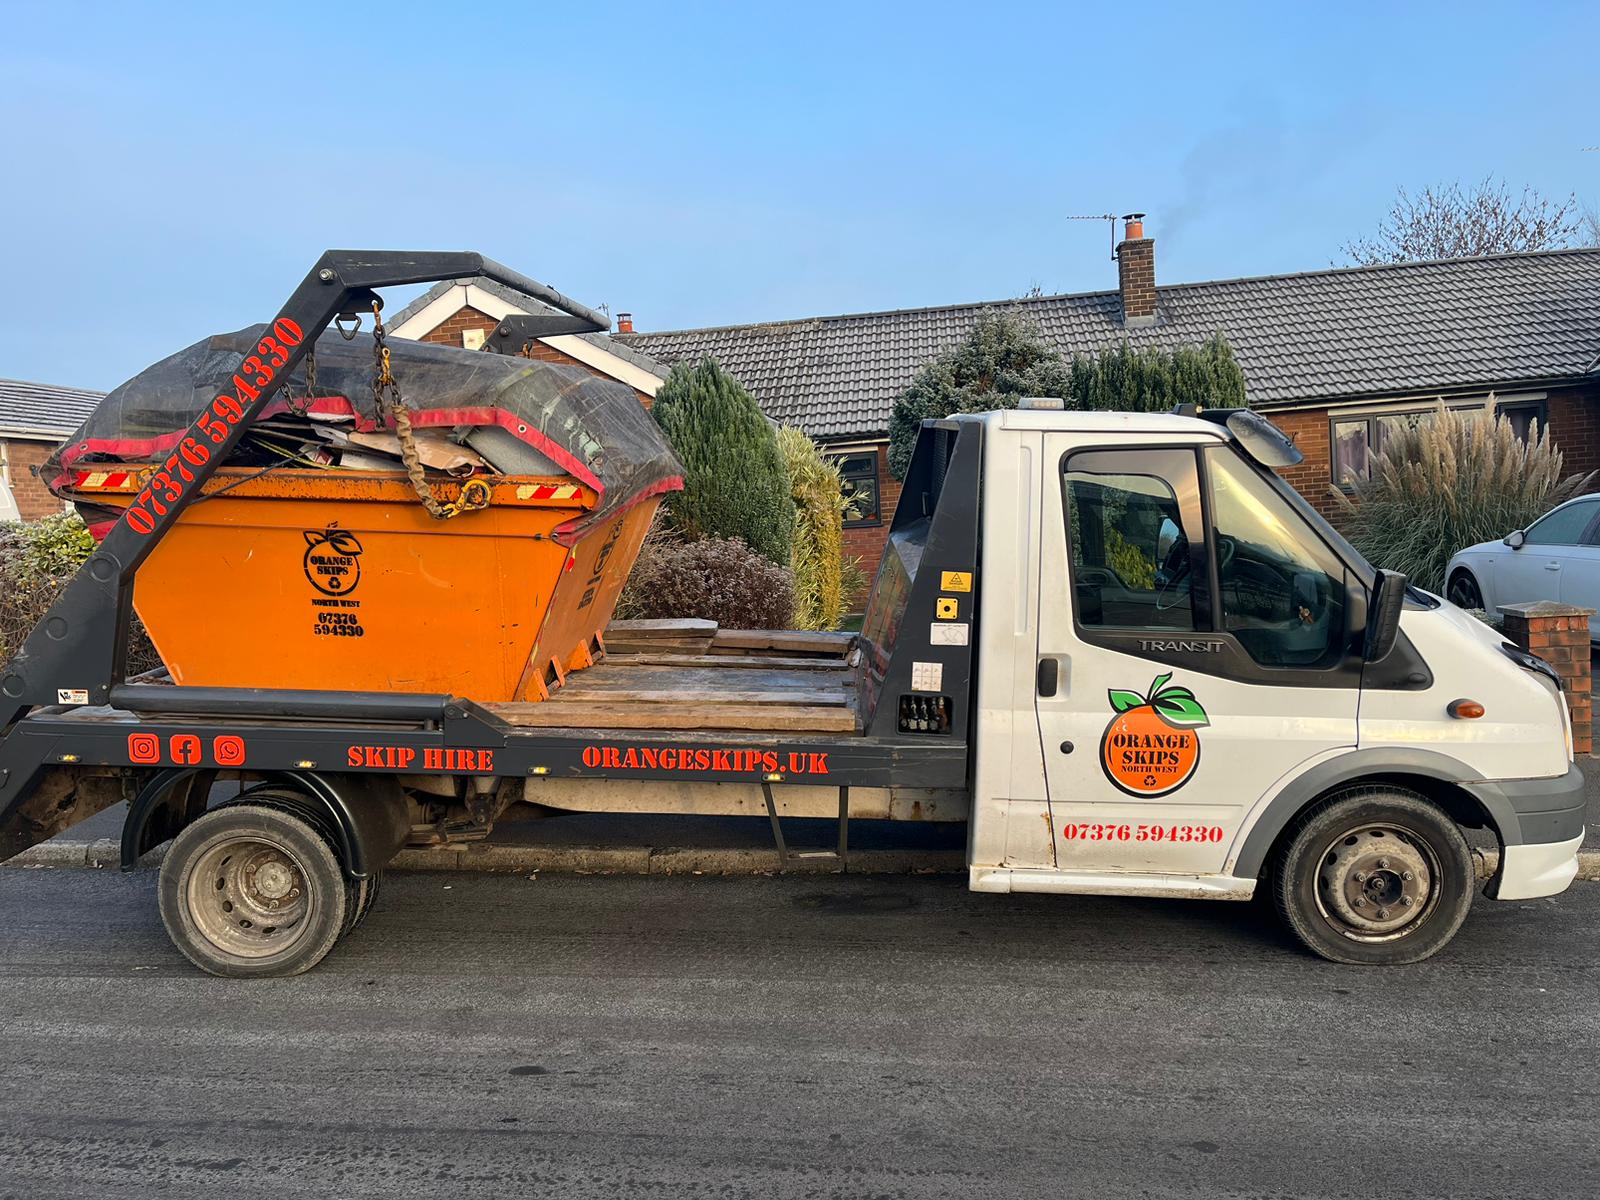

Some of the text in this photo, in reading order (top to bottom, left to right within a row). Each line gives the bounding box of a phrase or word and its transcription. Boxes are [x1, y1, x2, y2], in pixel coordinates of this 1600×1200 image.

[126, 317, 304, 534] 07376 594330
[310, 555, 353, 566] ORANGE
[317, 566, 349, 576] SKIPS
[311, 599, 360, 608] NORTH WEST
[318, 612, 358, 625] 07376
[314, 624, 364, 637] 594330
[1138, 640, 1224, 653] TRANSIT
[1113, 733, 1190, 749] ORANGE
[347, 745, 494, 771] SKIP HIRE
[582, 746, 829, 774] ORANGESKIPS.UK
[1121, 750, 1180, 766] SKIPS
[1121, 765, 1152, 773] NORTH
[1063, 824, 1224, 843] 07376 594330
